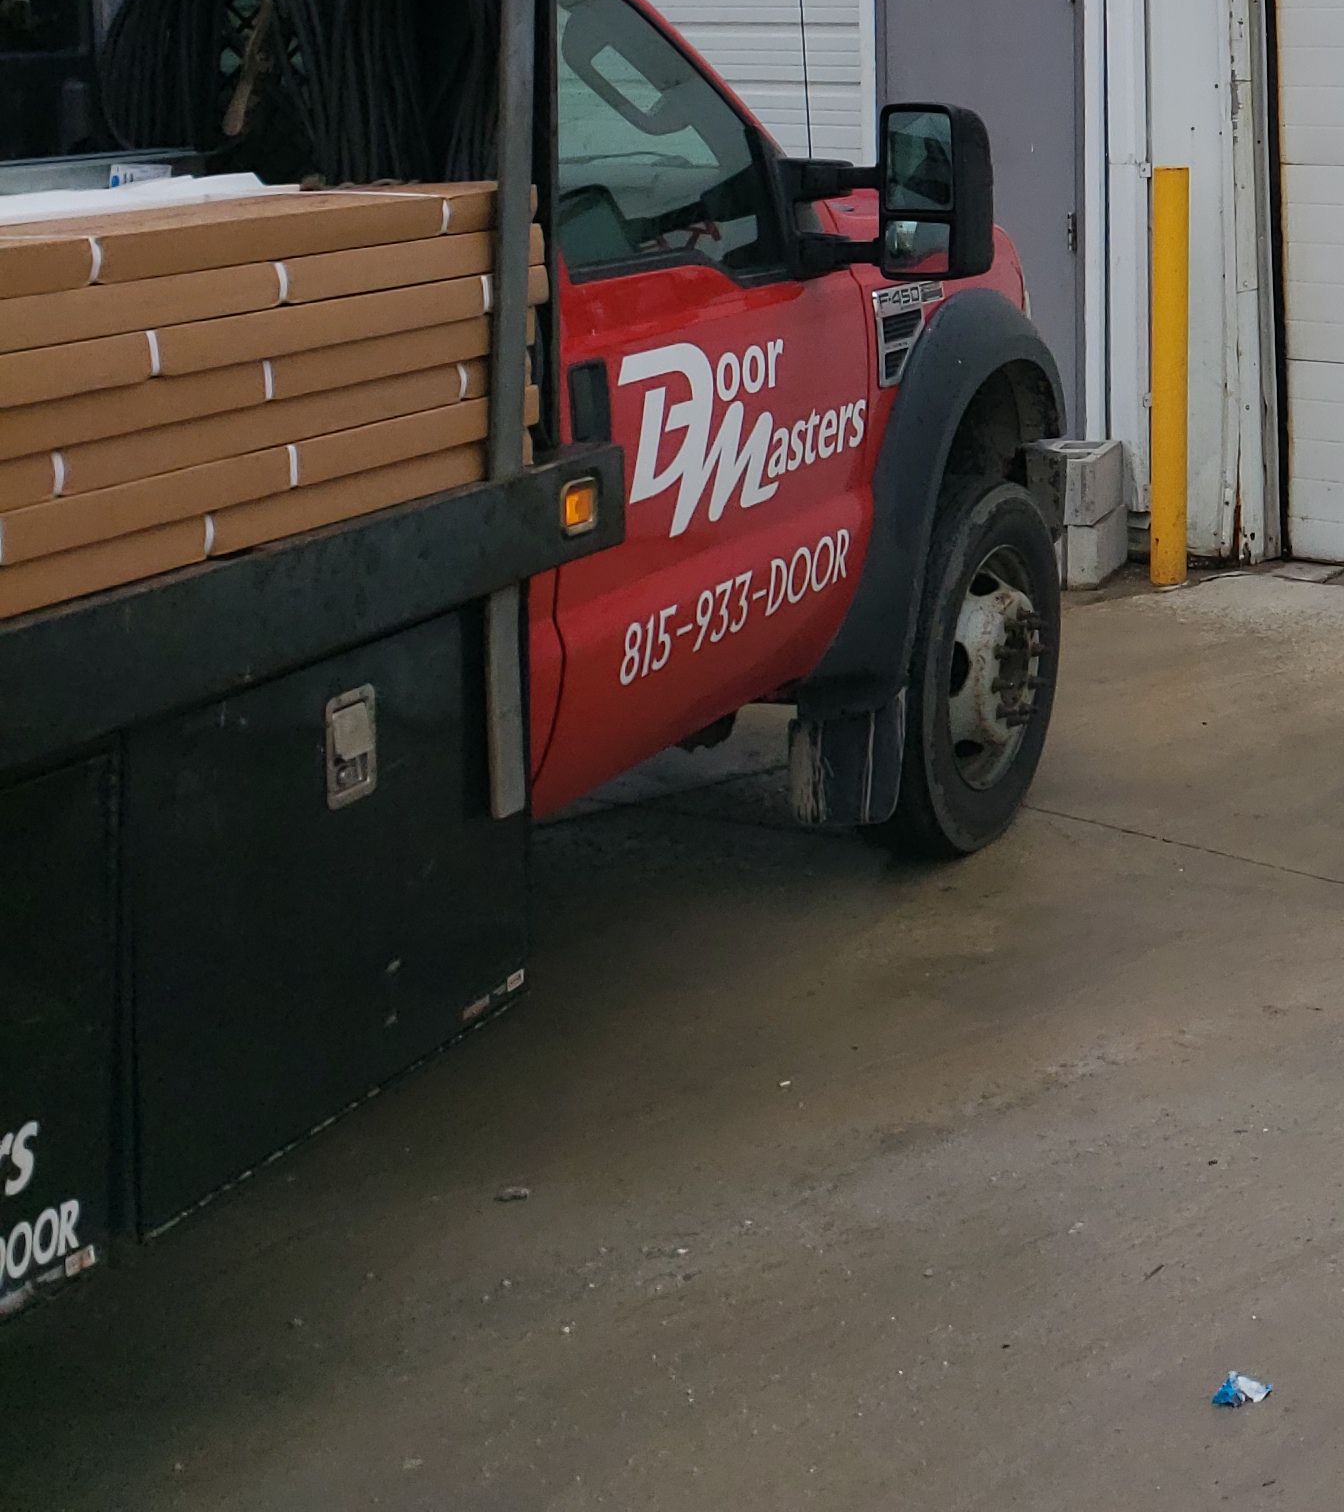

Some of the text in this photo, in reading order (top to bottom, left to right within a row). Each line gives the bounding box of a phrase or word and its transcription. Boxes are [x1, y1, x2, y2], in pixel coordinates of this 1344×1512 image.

[878, 286, 920, 305] F-450
[618, 339, 784, 505] Door
[669, 398, 867, 538] Masters
[619, 528, 851, 686] 815-933-DOOR
[0, 1199, 80, 1286] OOR
